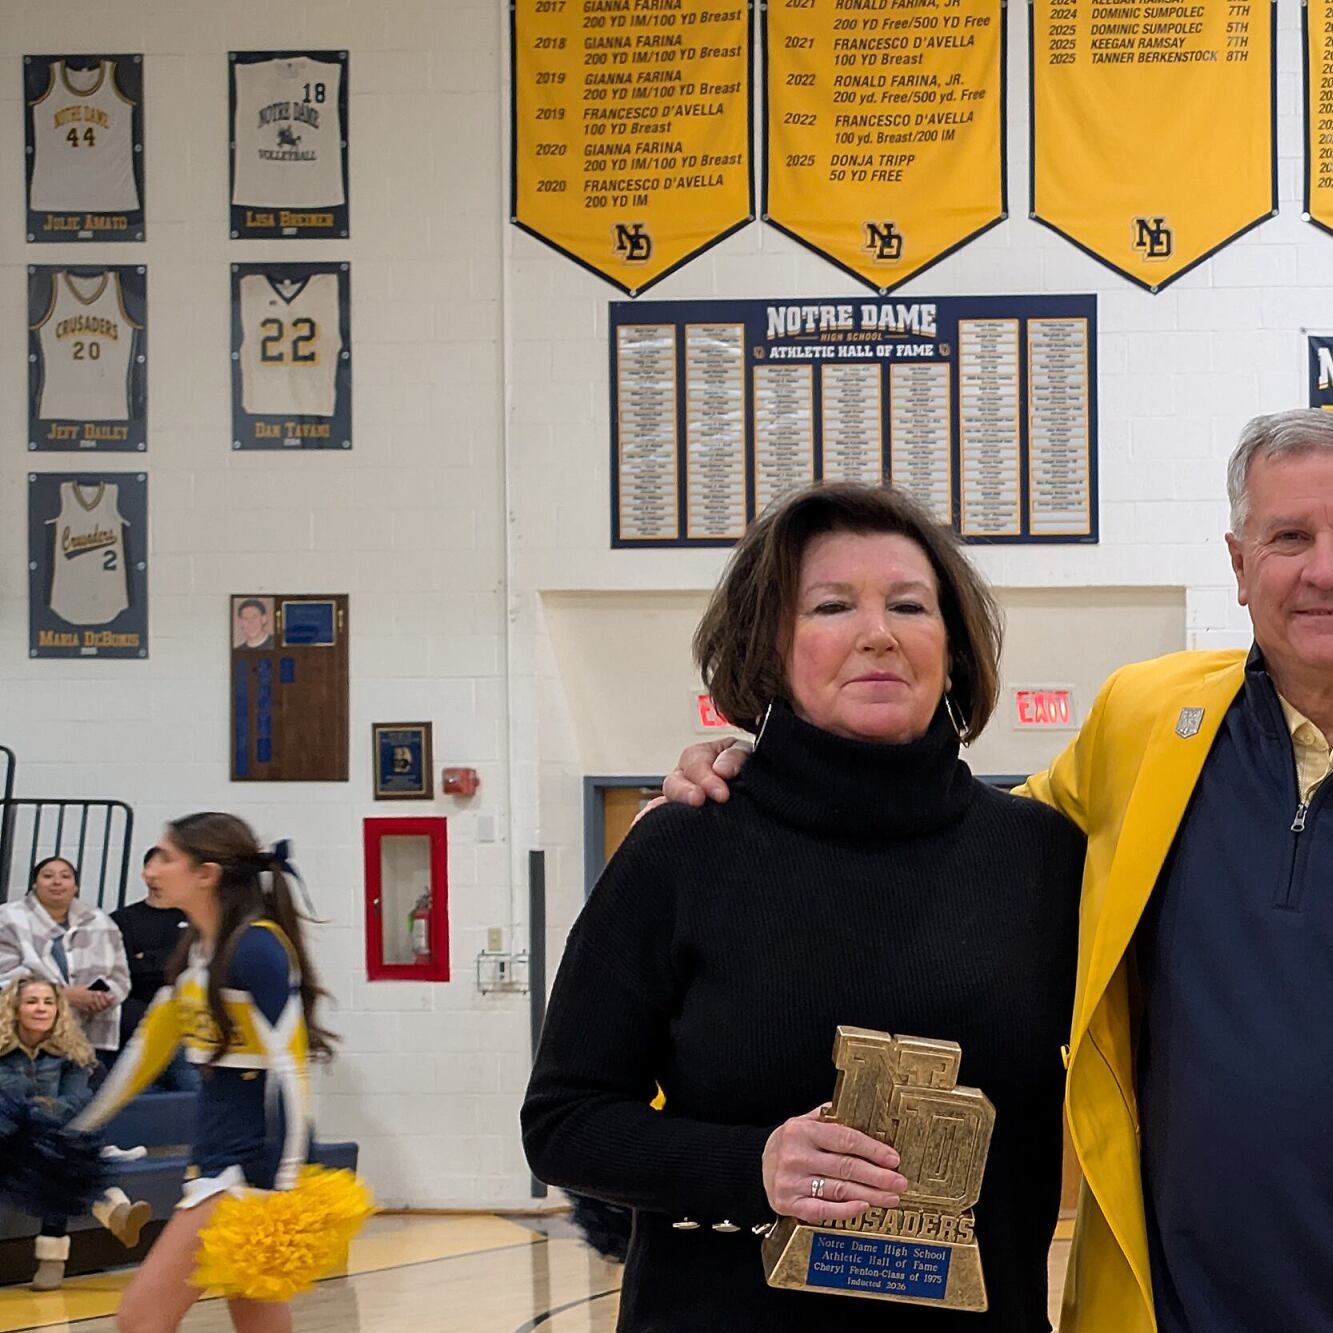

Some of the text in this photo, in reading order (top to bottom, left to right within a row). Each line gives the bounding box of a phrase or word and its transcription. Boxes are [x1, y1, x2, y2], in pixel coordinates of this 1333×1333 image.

[1049, 22, 1248, 36] 2025 DOMINIC SUMPOLEC 5TH
[534, 35, 682, 49] 2018 GIANNA FARINA
[303, 83, 325, 103] 18
[536, 104, 723, 120] 2019 FRANCESCO D'AVELLA
[583, 121, 671, 135] 100 YD Breast
[66, 128, 96, 147] 44
[786, 154, 916, 167] 2025 DONJA TRIPP
[830, 169, 903, 182] 50 YD FREE
[56, 314, 118, 341] CRUSADERS
[767, 303, 938, 341] NOTRE DAME
[260, 318, 317, 363] 22
[820, 332, 882, 342] HIGH SCHOOL
[73, 342, 100, 360] 20
[769, 345, 934, 359] ATHLETIC HALL OF FAME
[103, 551, 116, 571] 2
[1017, 690, 1070, 725] EXIT
[814, 1262, 844, 1275] Cheryl
[909, 1271, 921, 1282] of
[924, 1274, 942, 1285] 1975
